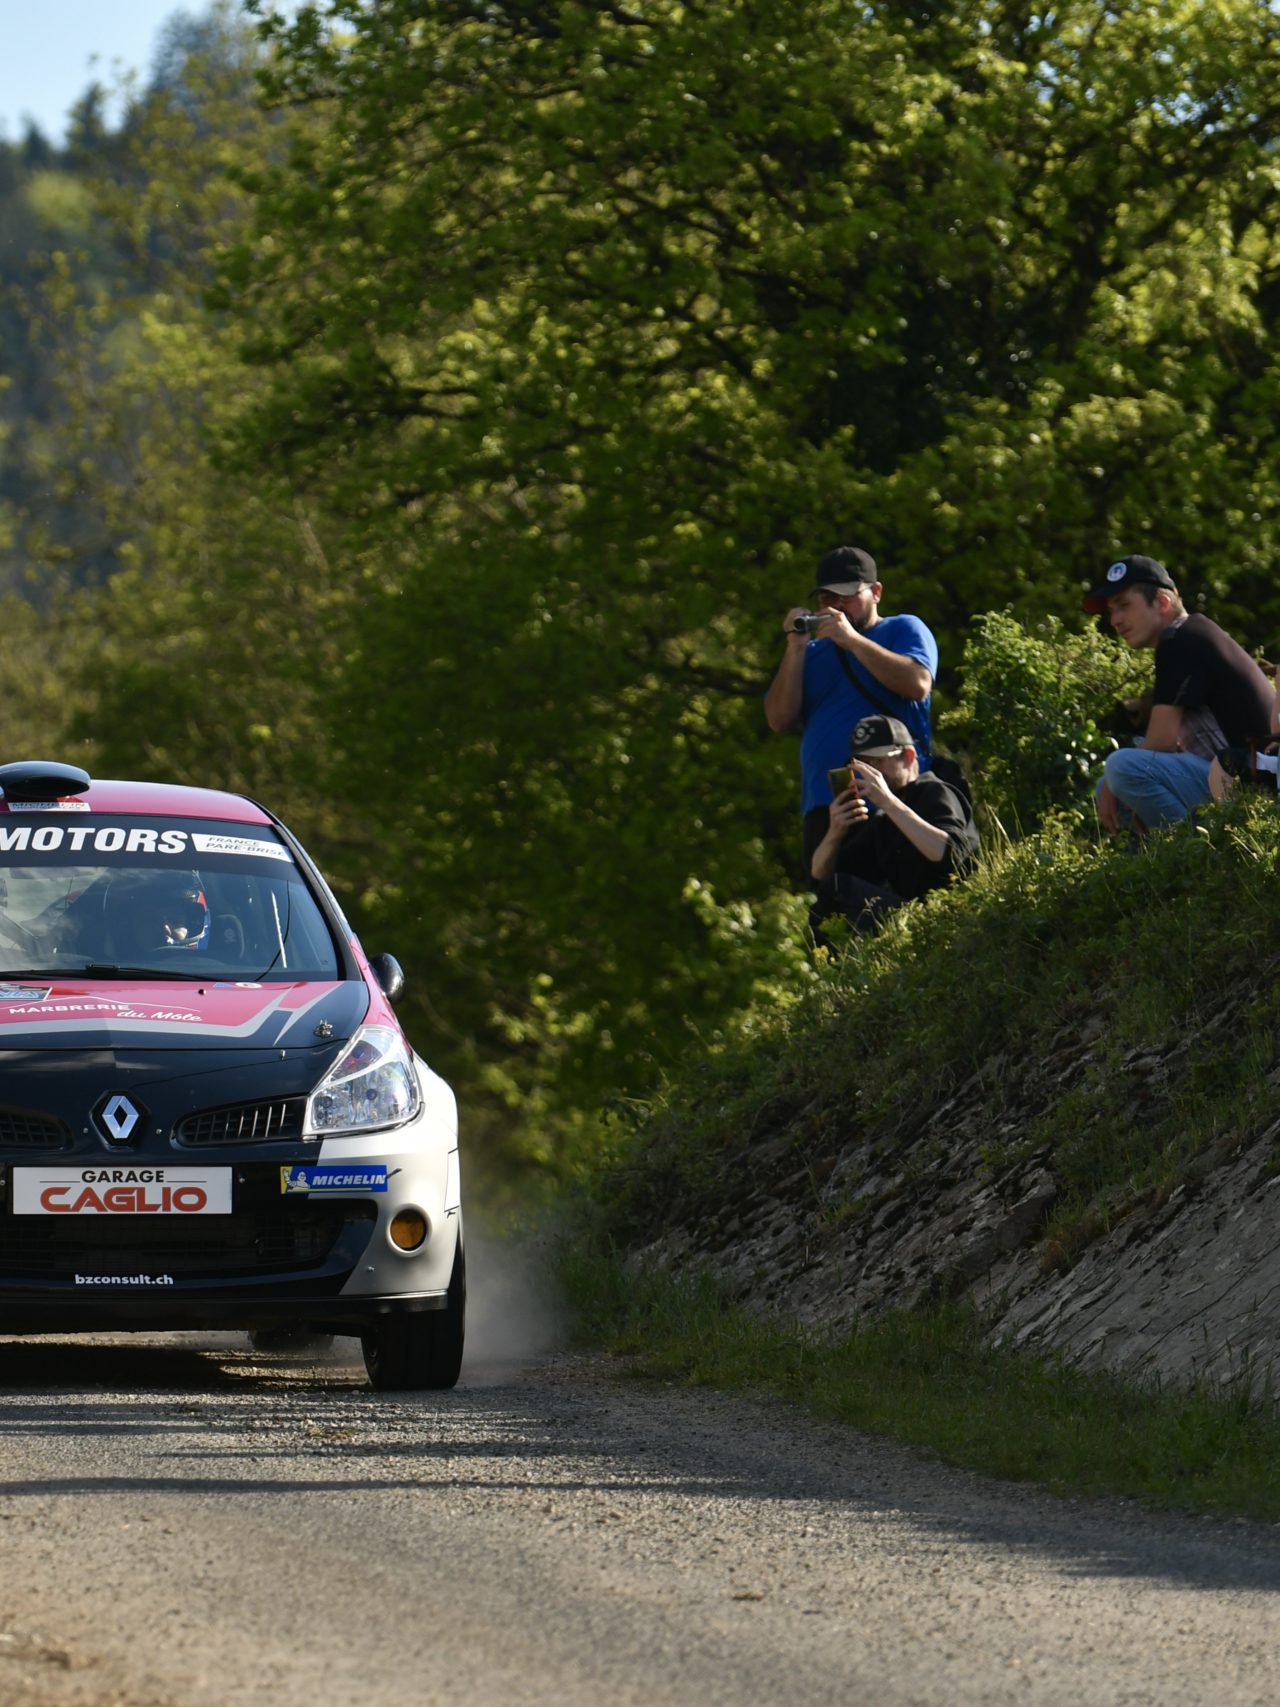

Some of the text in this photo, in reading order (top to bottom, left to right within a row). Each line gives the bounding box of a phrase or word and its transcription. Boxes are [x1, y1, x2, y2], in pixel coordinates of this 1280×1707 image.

[208, 837, 261, 847] FRANCE
[9, 1004, 130, 1014] MARBRERIE
[116, 1010, 146, 1018] du
[81, 1170, 164, 1183] GARAGE
[312, 1174, 387, 1186] MICHELIN
[40, 1186, 208, 1212] CAGLIO
[75, 1274, 174, 1285] bzconsult.ch
